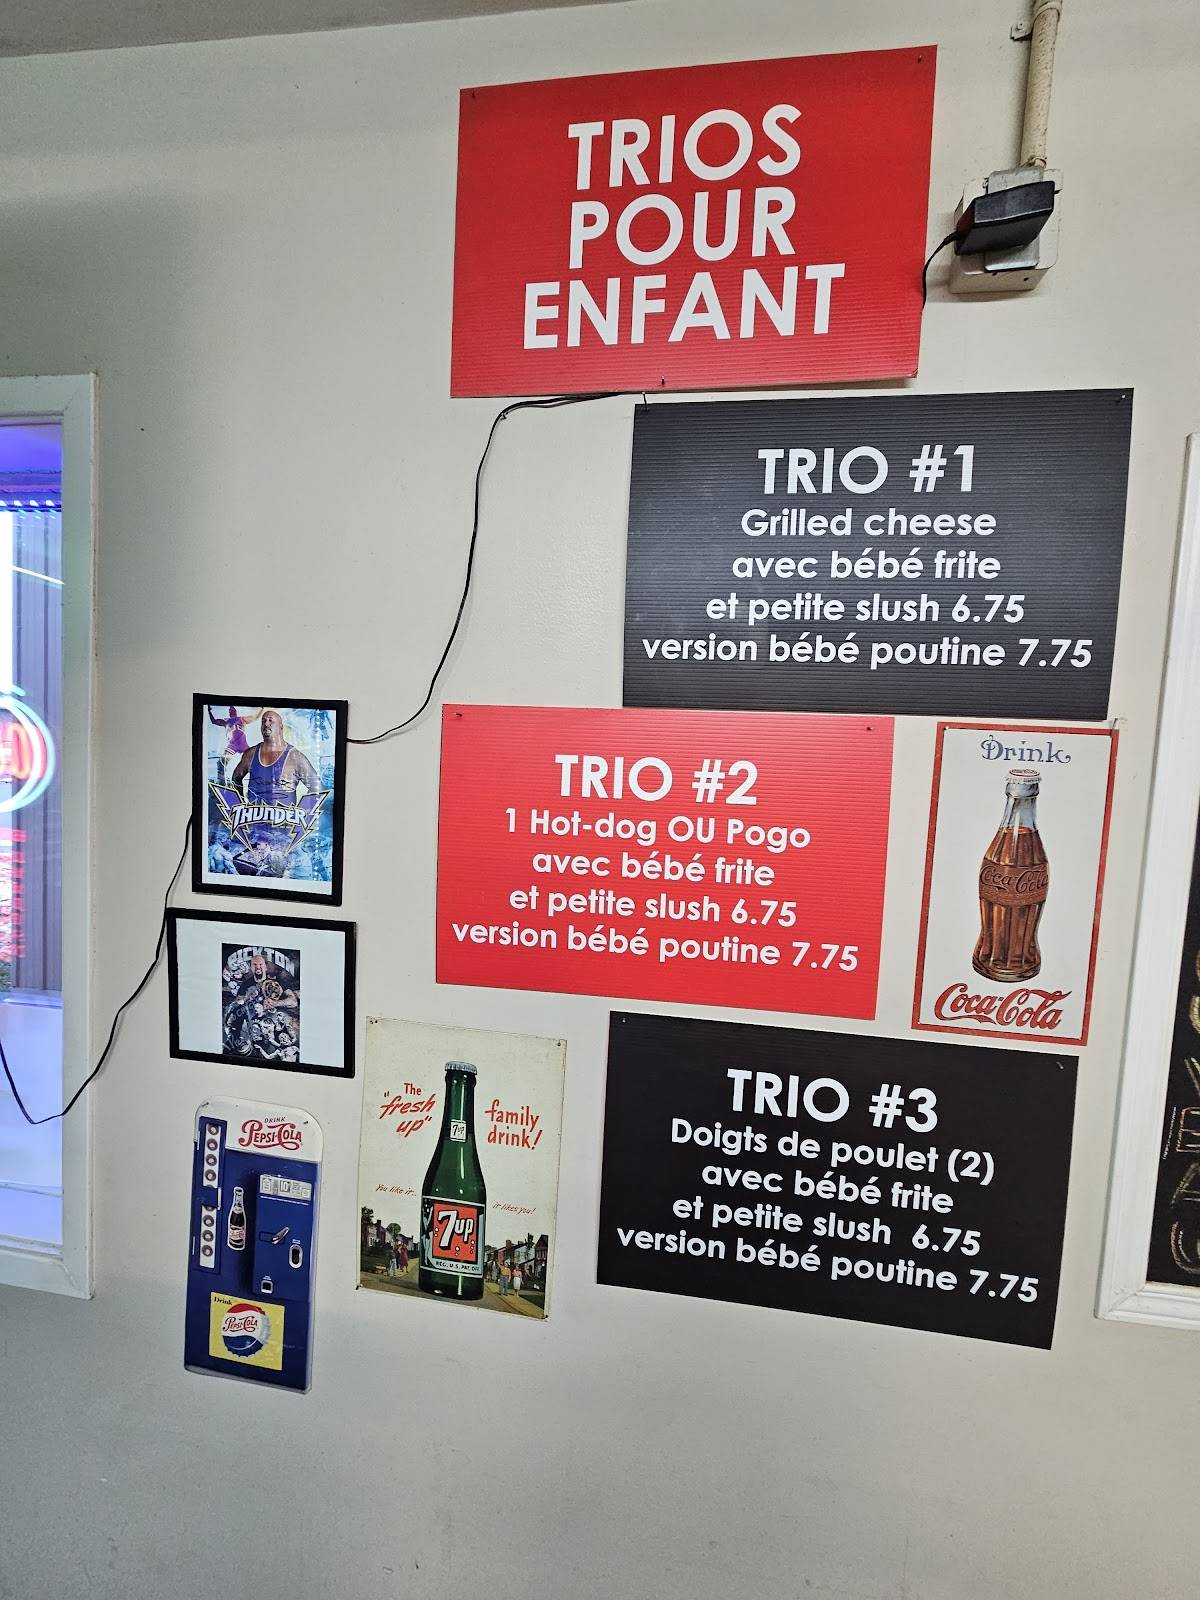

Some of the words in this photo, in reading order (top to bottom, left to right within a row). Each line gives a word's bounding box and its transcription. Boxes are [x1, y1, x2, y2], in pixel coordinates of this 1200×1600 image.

[568, 104, 801, 193] TRIOS
[567, 187, 795, 269] POUR
[524, 263, 845, 349] ENFANT
[758, 446, 888, 496] TRIO
[910, 445, 974, 492] #1
[741, 508, 852, 537] Grilled
[864, 508, 996, 537] cheese
[733, 556, 818, 579] avec
[831, 547, 923, 579] bébé
[934, 550, 1000, 580] frite
[706, 593, 739, 620] et
[749, 592, 844, 627] petite
[856, 593, 939, 622] slush
[952, 594, 1025, 623] 6.75
[643, 633, 757, 661] version
[770, 632, 859, 665] bébé
[871, 637, 1005, 671] poutine
[1019, 639, 1092, 668] 7.75
[980, 734, 1072, 764] Drink
[555, 755, 672, 802] TRIO
[692, 759, 757, 806] #2
[506, 808, 515, 832] 1
[531, 809, 656, 847] Hot-dog
[668, 816, 715, 844] OU
[727, 819, 810, 854] Pogo
[533, 854, 610, 877] avec
[622, 851, 702, 883] bébé
[715, 857, 774, 886] frite
[510, 886, 539, 911] et
[548, 888, 635, 924] petite
[645, 896, 720, 922] slush
[732, 899, 796, 928] 6.75
[452, 921, 556, 949] version
[568, 925, 646, 956] bébé
[660, 934, 780, 968] poutine
[793, 942, 858, 971] 7.75
[934, 982, 1072, 1029] Coca-Cola
[379, 1091, 437, 1120] "fresh
[404, 1082, 422, 1096] The
[727, 1069, 849, 1123] TRIO
[869, 1084, 937, 1133] #3
[264, 1116, 286, 1124] DRINK
[396, 1117, 432, 1138] up"
[485, 1099, 540, 1132] family
[487, 1128, 542, 1150] drink!
[672, 1118, 772, 1154] Doigts
[778, 1131, 820, 1159] de
[831, 1142, 938, 1173] poulet
[948, 1149, 994, 1186] (2)
[702, 1166, 783, 1193] avec
[795, 1170, 881, 1205] bébé
[892, 1182, 953, 1214] frite
[437, 1210, 475, 1248] 7up
[673, 1196, 703, 1220] et
[713, 1204, 803, 1233] petite
[813, 1212, 891, 1245] slush
[912, 1224, 980, 1257] 6.75
[617, 1228, 724, 1260] version
[736, 1238, 818, 1272] bébé
[831, 1257, 957, 1291] poutine
[970, 1269, 1038, 1303] 7.75
[213, 1296, 233, 1306] Drink
